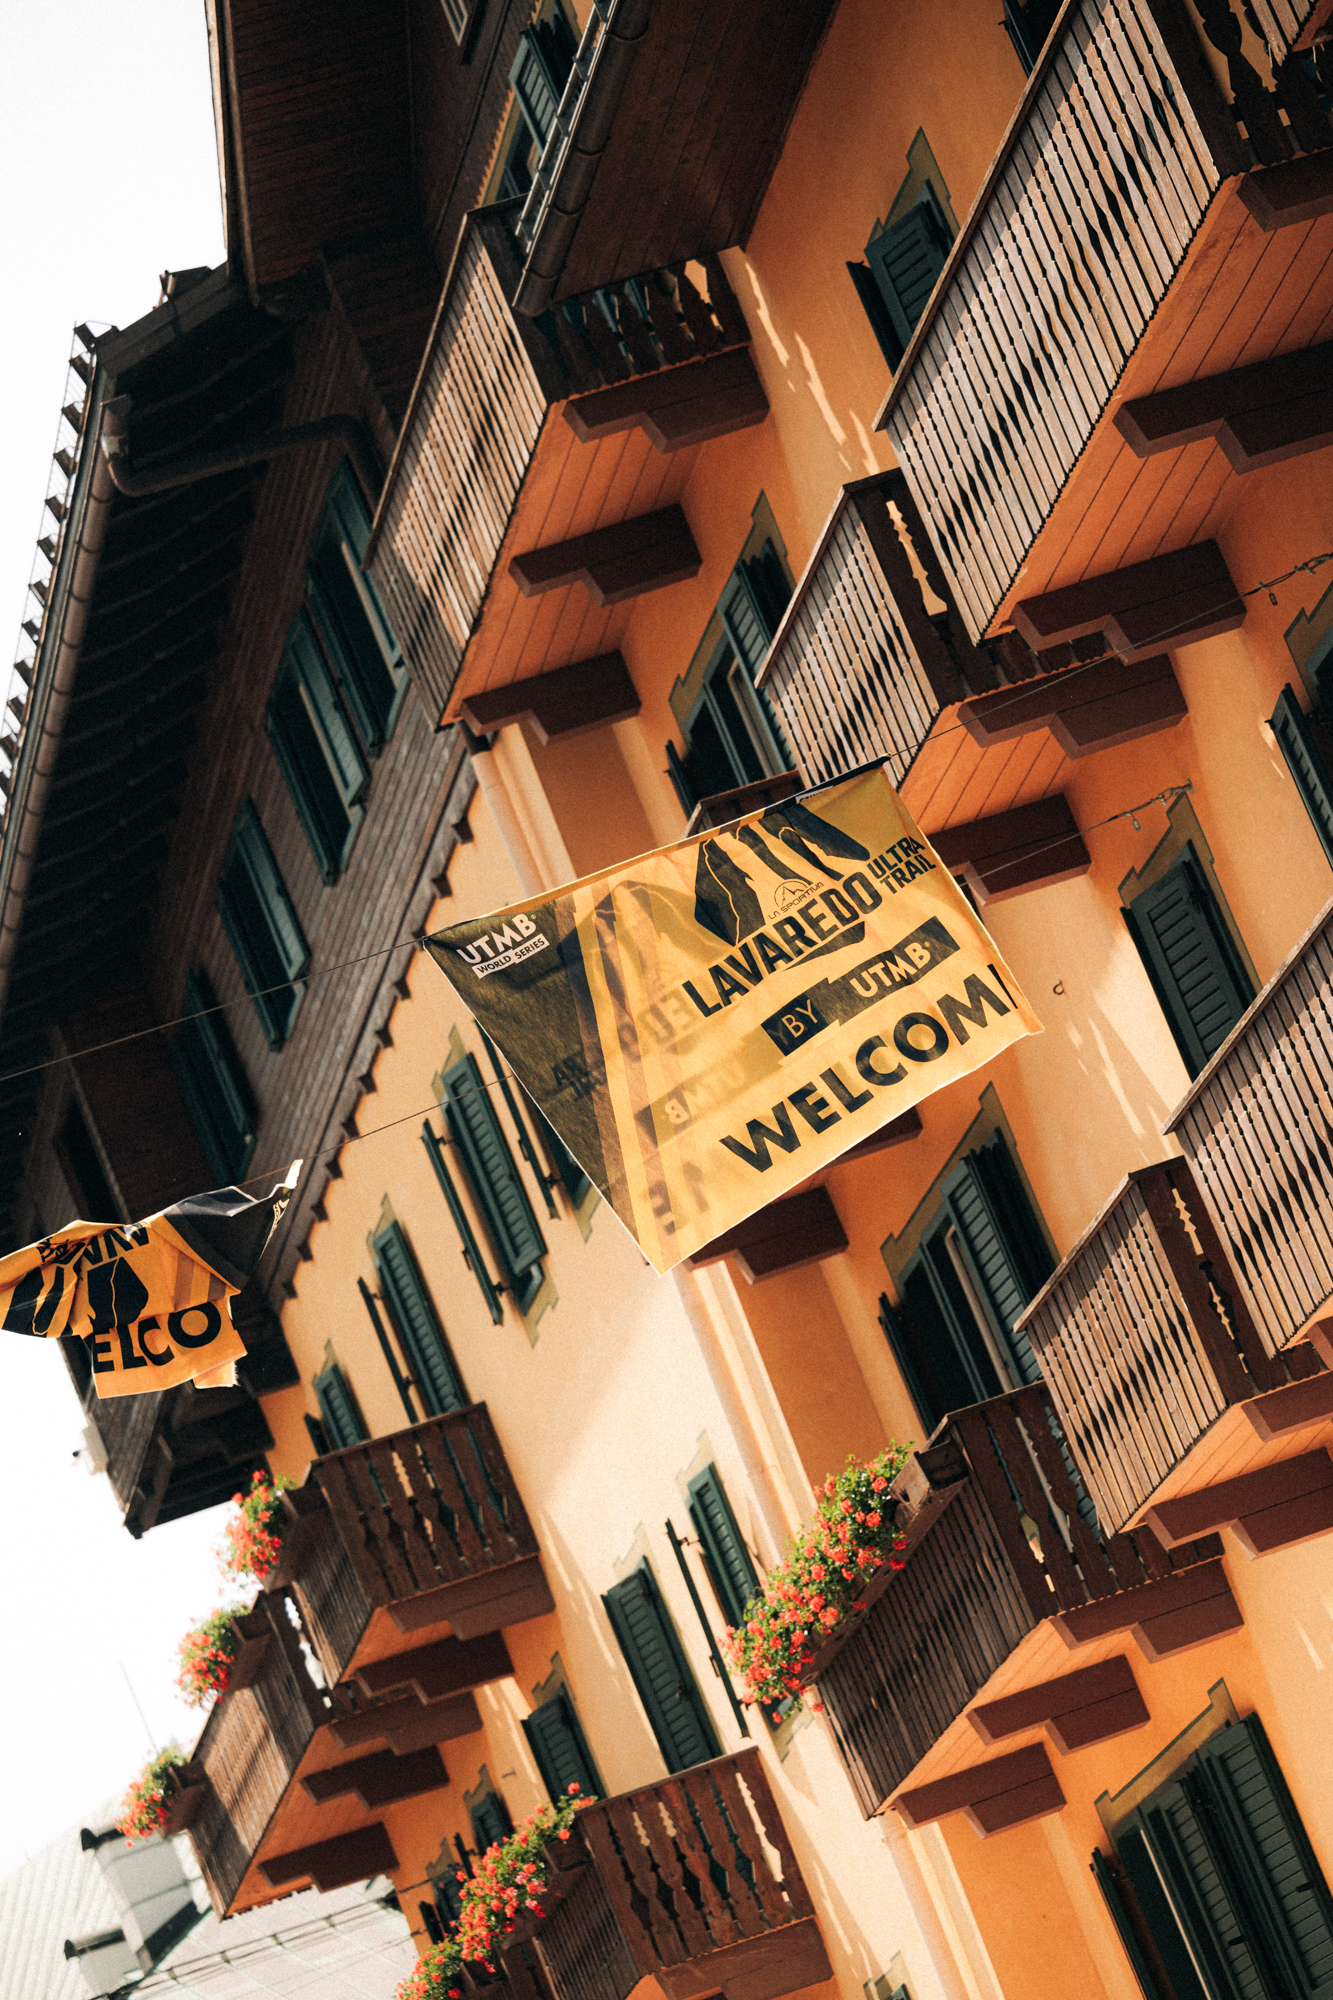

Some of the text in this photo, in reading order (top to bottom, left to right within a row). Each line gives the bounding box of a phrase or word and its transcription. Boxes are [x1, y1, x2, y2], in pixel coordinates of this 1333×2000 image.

[867, 836, 926, 879] ULTRA
[880, 854, 937, 894] TRAIL
[767, 881, 825, 920] LA SPORTIVA
[477, 938, 546, 974] WORLD SERIES
[682, 872, 883, 1018] LAVAREDO
[783, 999, 818, 1039] BY
[719, 964, 1018, 1173] WELCOM
[92, 1302, 222, 1374] ELCO
